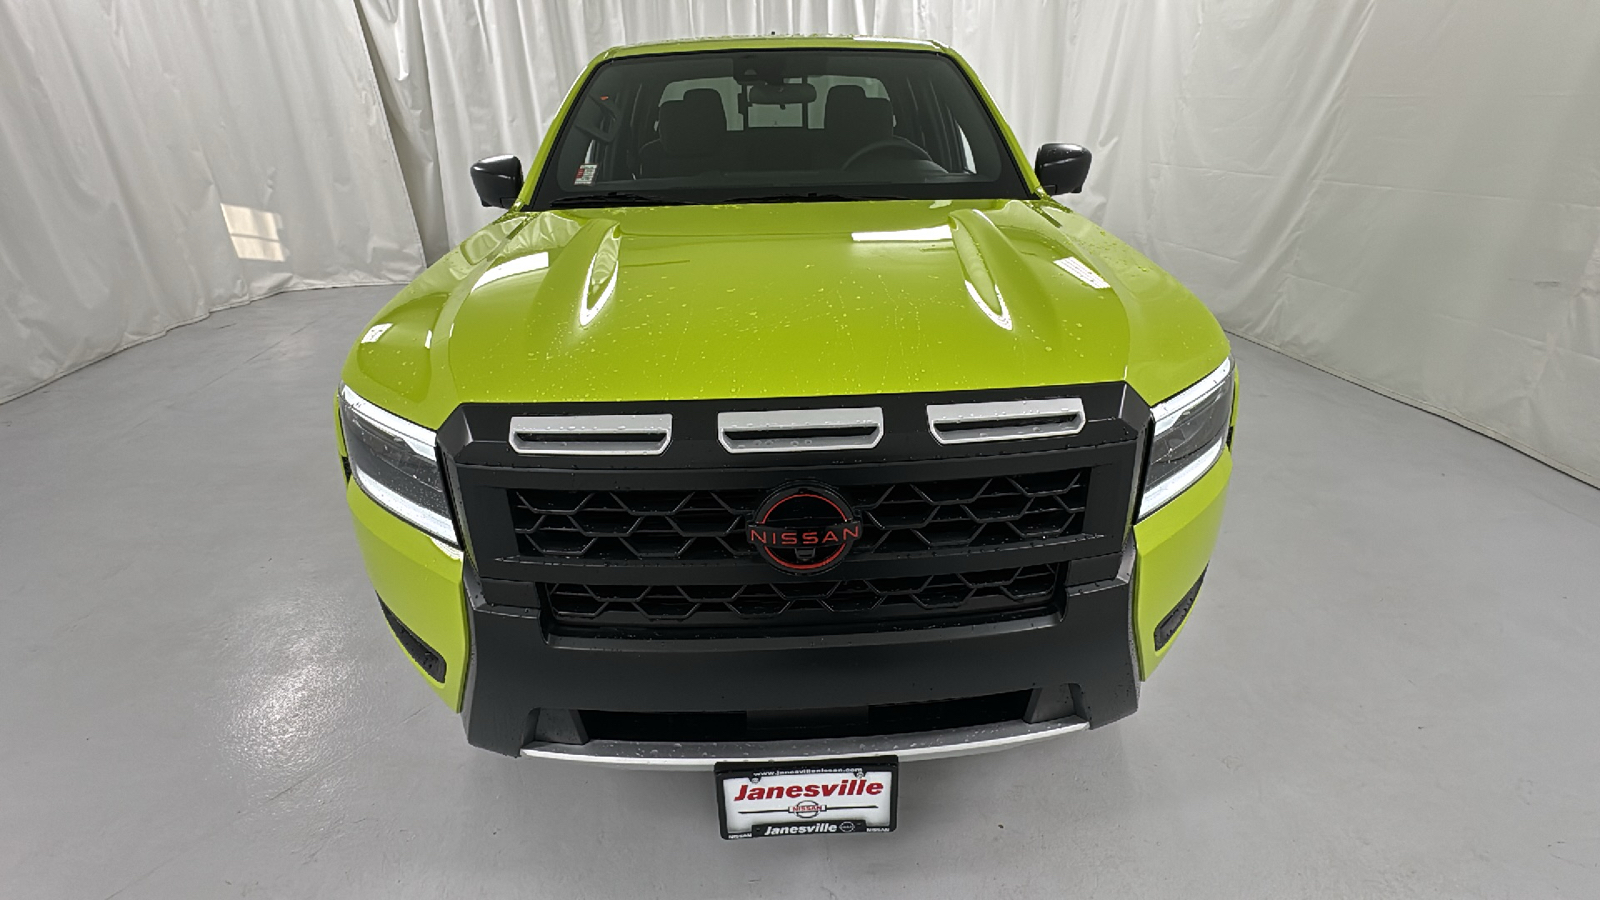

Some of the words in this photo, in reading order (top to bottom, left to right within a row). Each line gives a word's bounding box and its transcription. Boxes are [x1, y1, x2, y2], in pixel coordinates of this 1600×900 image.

[750, 525, 859, 545] NISSAN
[734, 779, 884, 802] Janesville
[764, 822, 838, 836] Janesville
